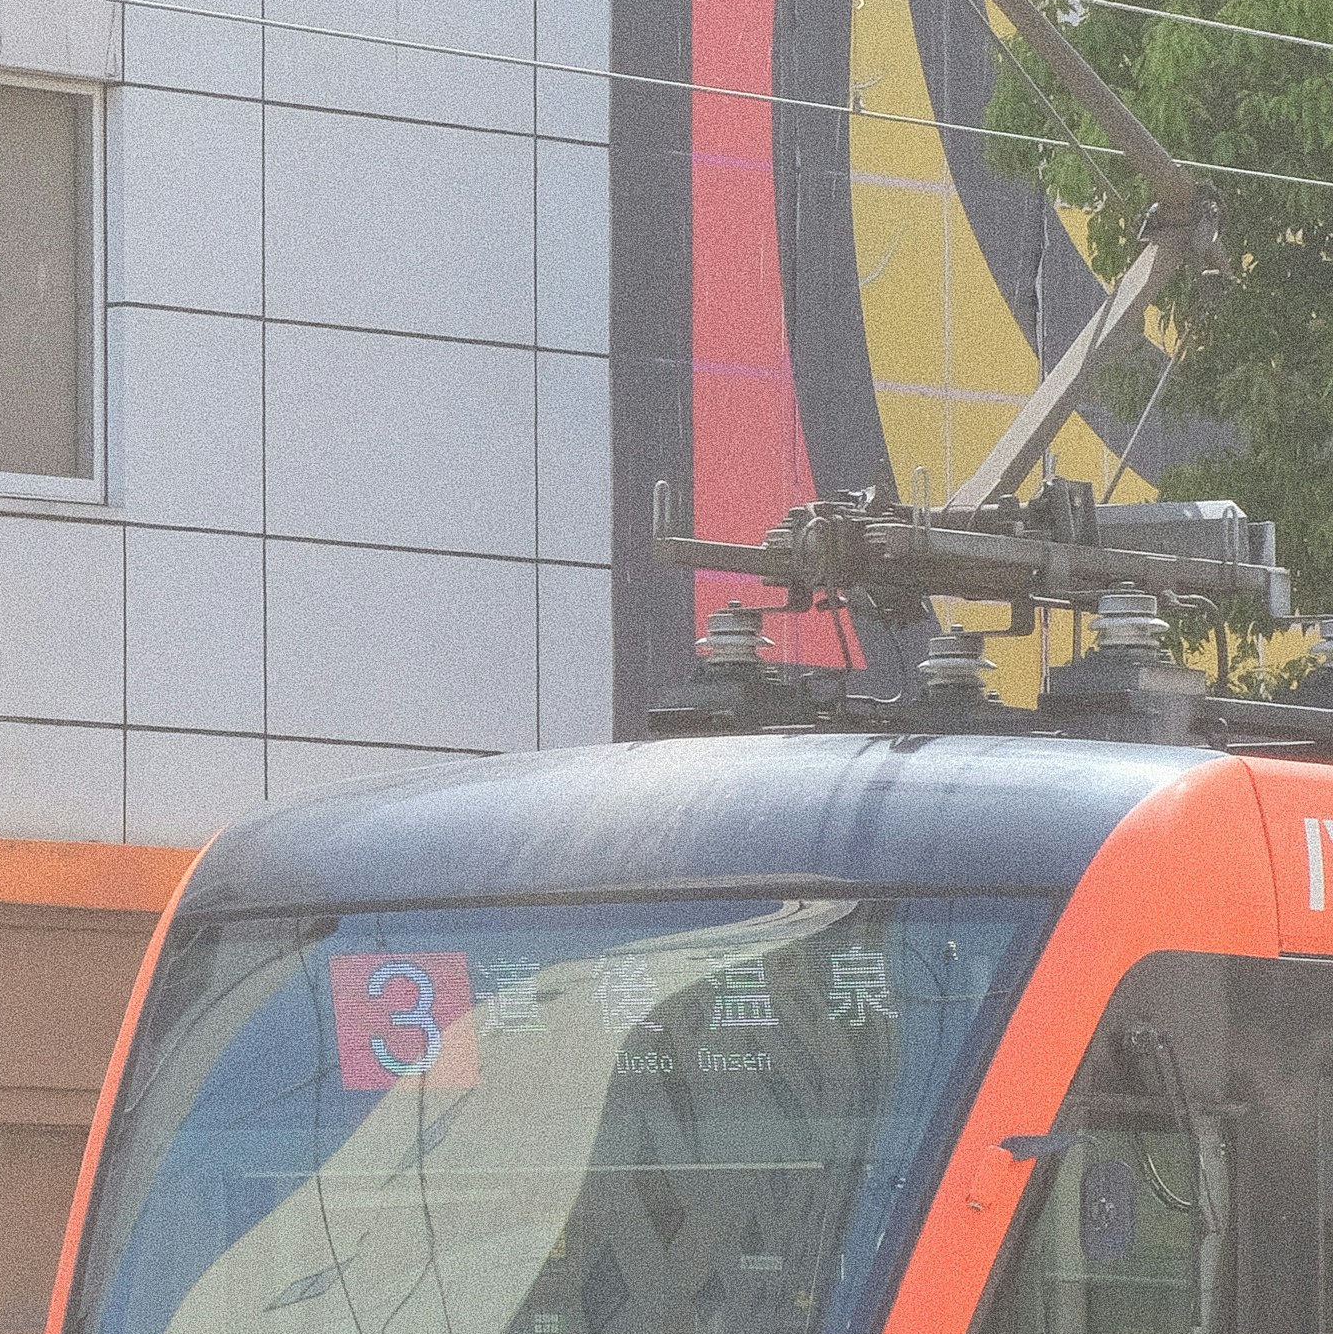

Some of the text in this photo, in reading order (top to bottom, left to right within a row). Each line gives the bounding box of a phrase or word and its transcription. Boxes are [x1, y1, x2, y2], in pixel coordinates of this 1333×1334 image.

[368, 945, 900, 1078] 3 道後温泉
[697, 1047, 772, 1072] Onsen
